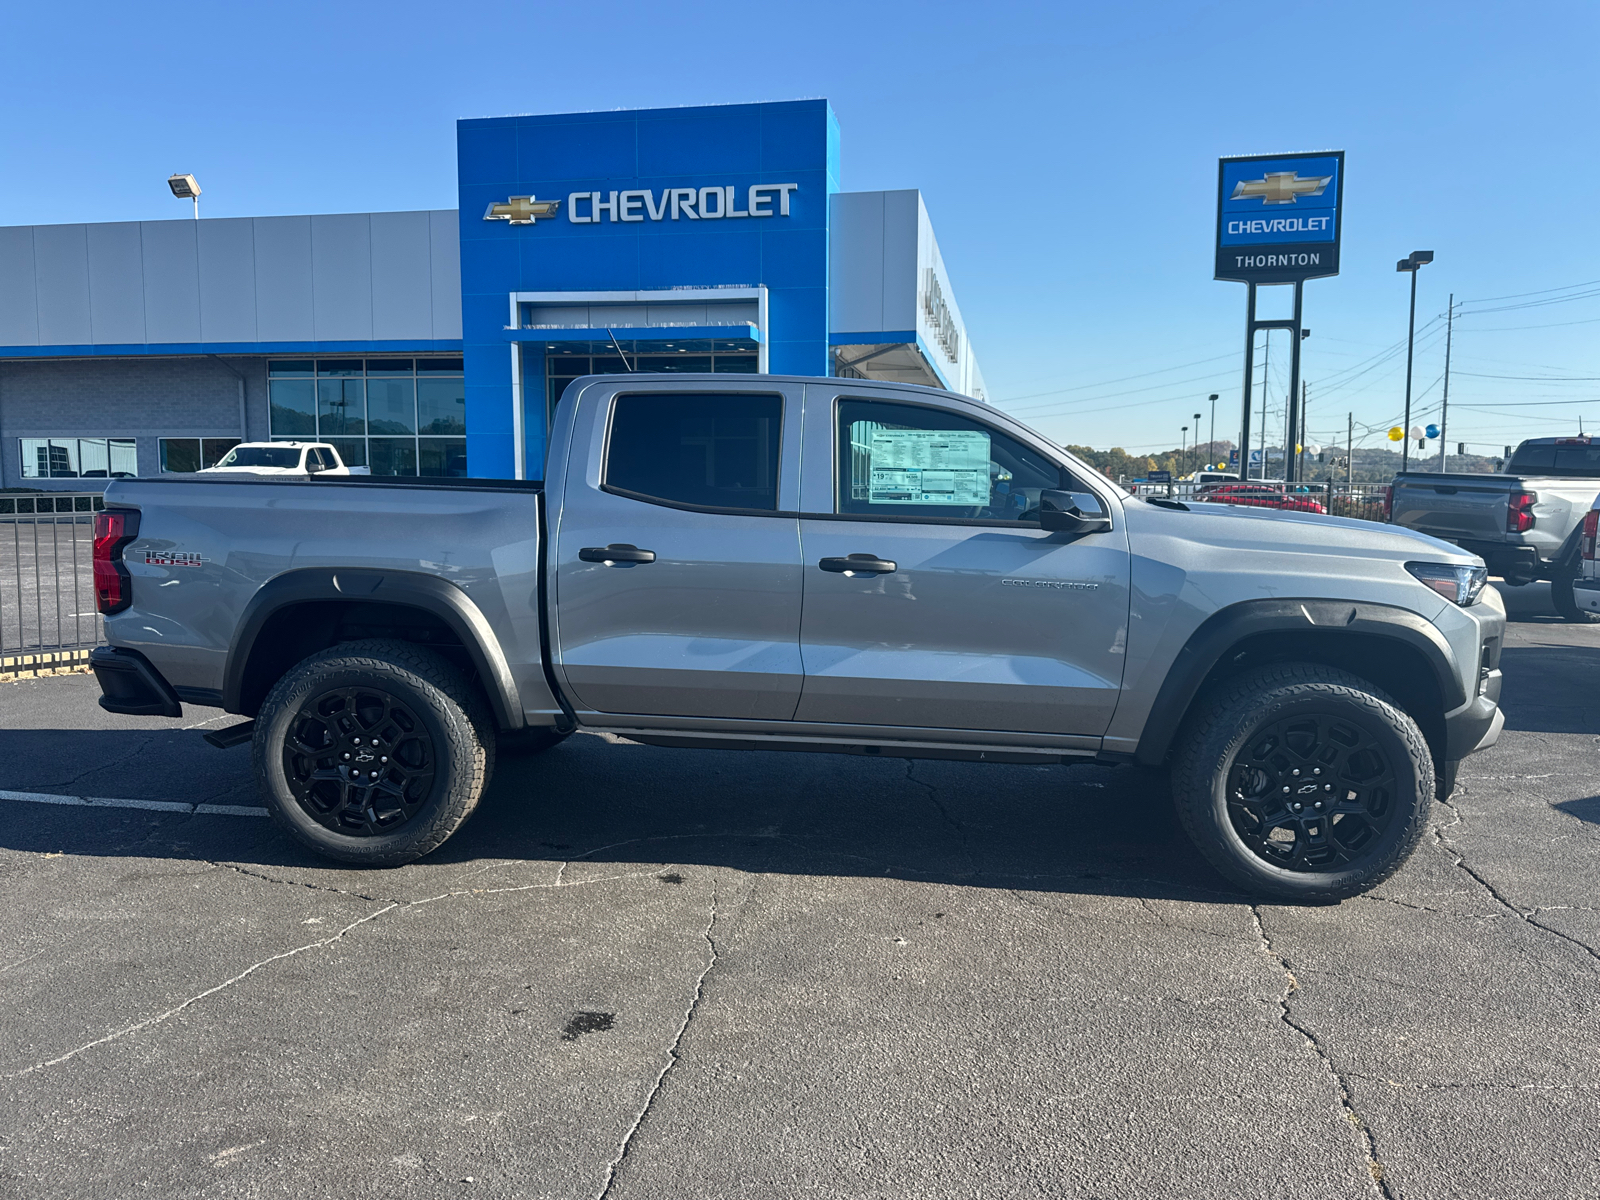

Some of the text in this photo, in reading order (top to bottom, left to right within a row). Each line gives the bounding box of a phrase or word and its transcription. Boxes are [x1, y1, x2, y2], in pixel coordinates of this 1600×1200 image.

[568, 183, 798, 223] CHEVROLET
[1228, 217, 1330, 234] CHEVROLET
[1235, 253, 1320, 268] THORNTON
[135, 549, 211, 562] TRAIL
[145, 558, 202, 567] BOSS
[1001, 579, 1099, 591] COLORADO
